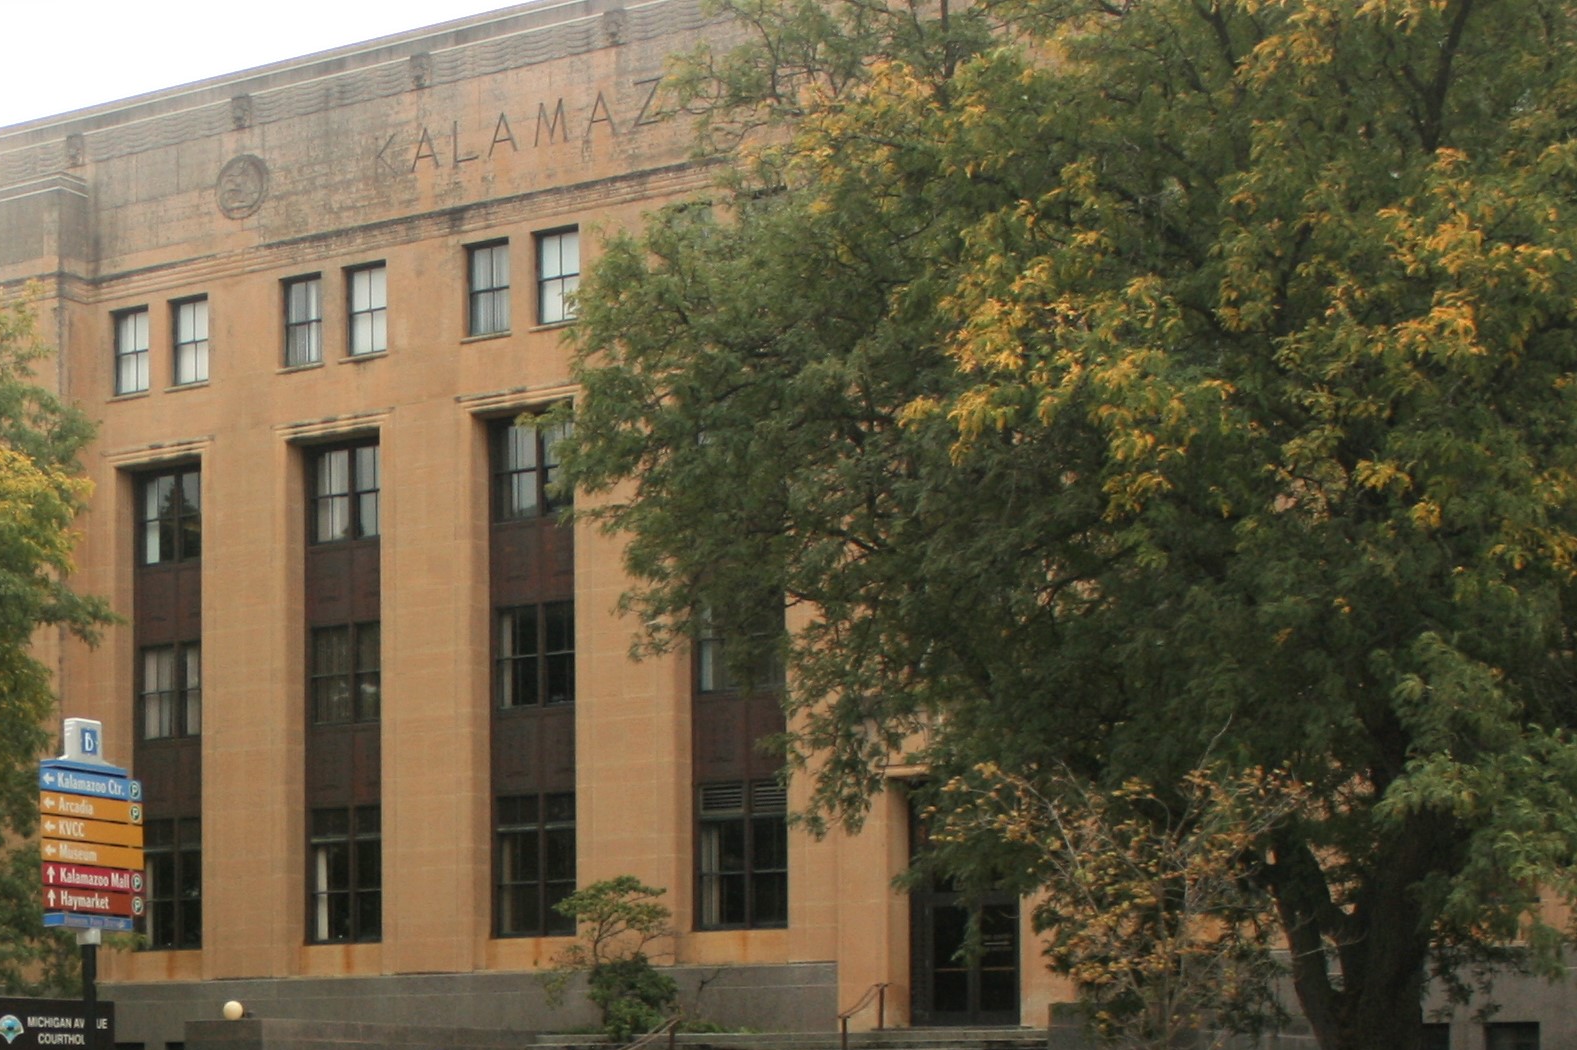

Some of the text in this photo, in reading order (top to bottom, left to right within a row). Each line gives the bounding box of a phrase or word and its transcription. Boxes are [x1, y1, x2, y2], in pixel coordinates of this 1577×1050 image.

[374, 76, 664, 178] KALAMAZ
[57, 772, 107, 793] Kalamazoo
[108, 779, 124, 796] Ctr.
[58, 797, 94, 815] Arcadia
[59, 820, 84, 837] KVCC
[59, 844, 97, 861] Museum
[60, 867, 109, 886] Kalamazoo
[111, 873, 130, 888] Mall
[60, 890, 109, 910] Haymarket
[27, 1016, 108, 1029] MICHIGAN AVUE
